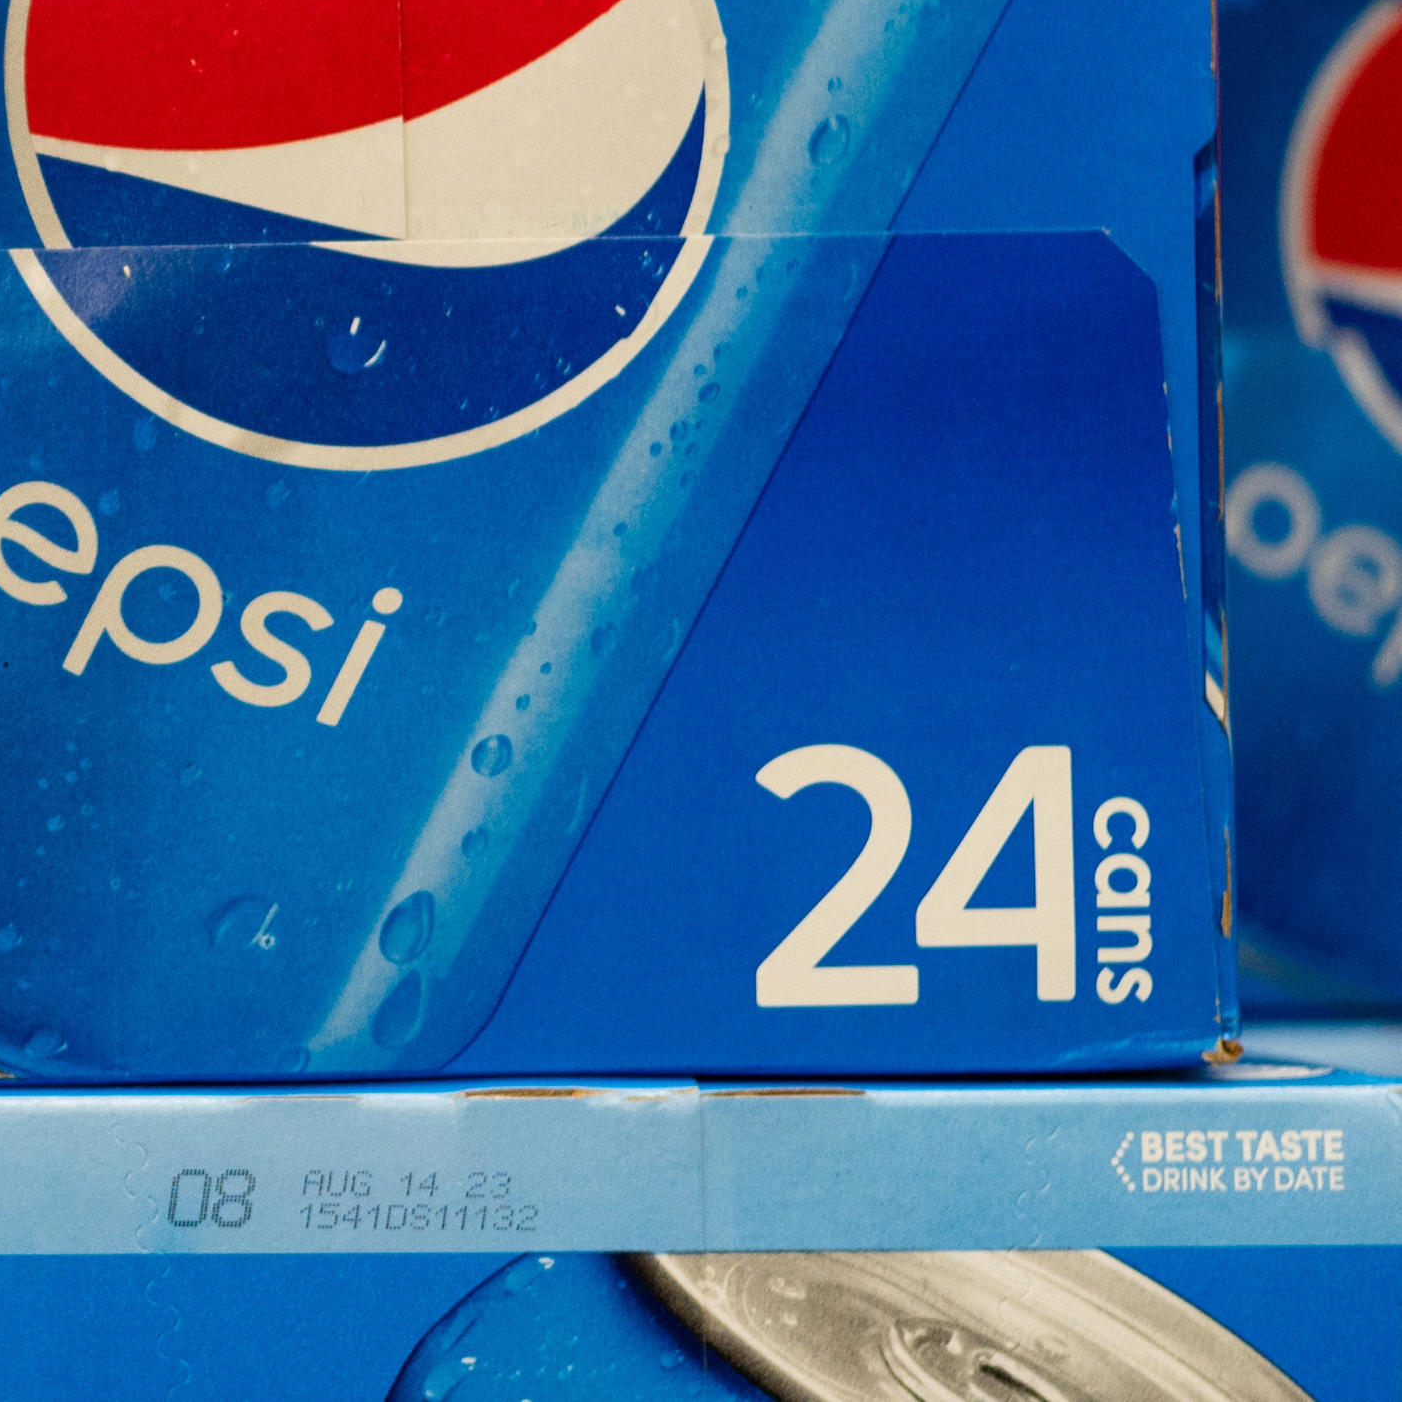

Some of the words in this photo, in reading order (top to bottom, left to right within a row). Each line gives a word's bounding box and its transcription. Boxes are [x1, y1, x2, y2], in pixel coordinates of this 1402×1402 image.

[755, 744, 1076, 1007] 24
[1093, 796, 1154, 1005] cans
[1141, 1130, 1229, 1163] BEST
[1235, 1129, 1345, 1162] TASTE
[167, 1168, 256, 1228] 08
[302, 1170, 373, 1197] AUG
[400, 1171, 438, 1197] 14
[465, 1171, 512, 1198] 23
[1142, 1167, 1227, 1192] DRINK
[1234, 1166, 1269, 1192] BY
[1274, 1165, 1345, 1191] DATE
